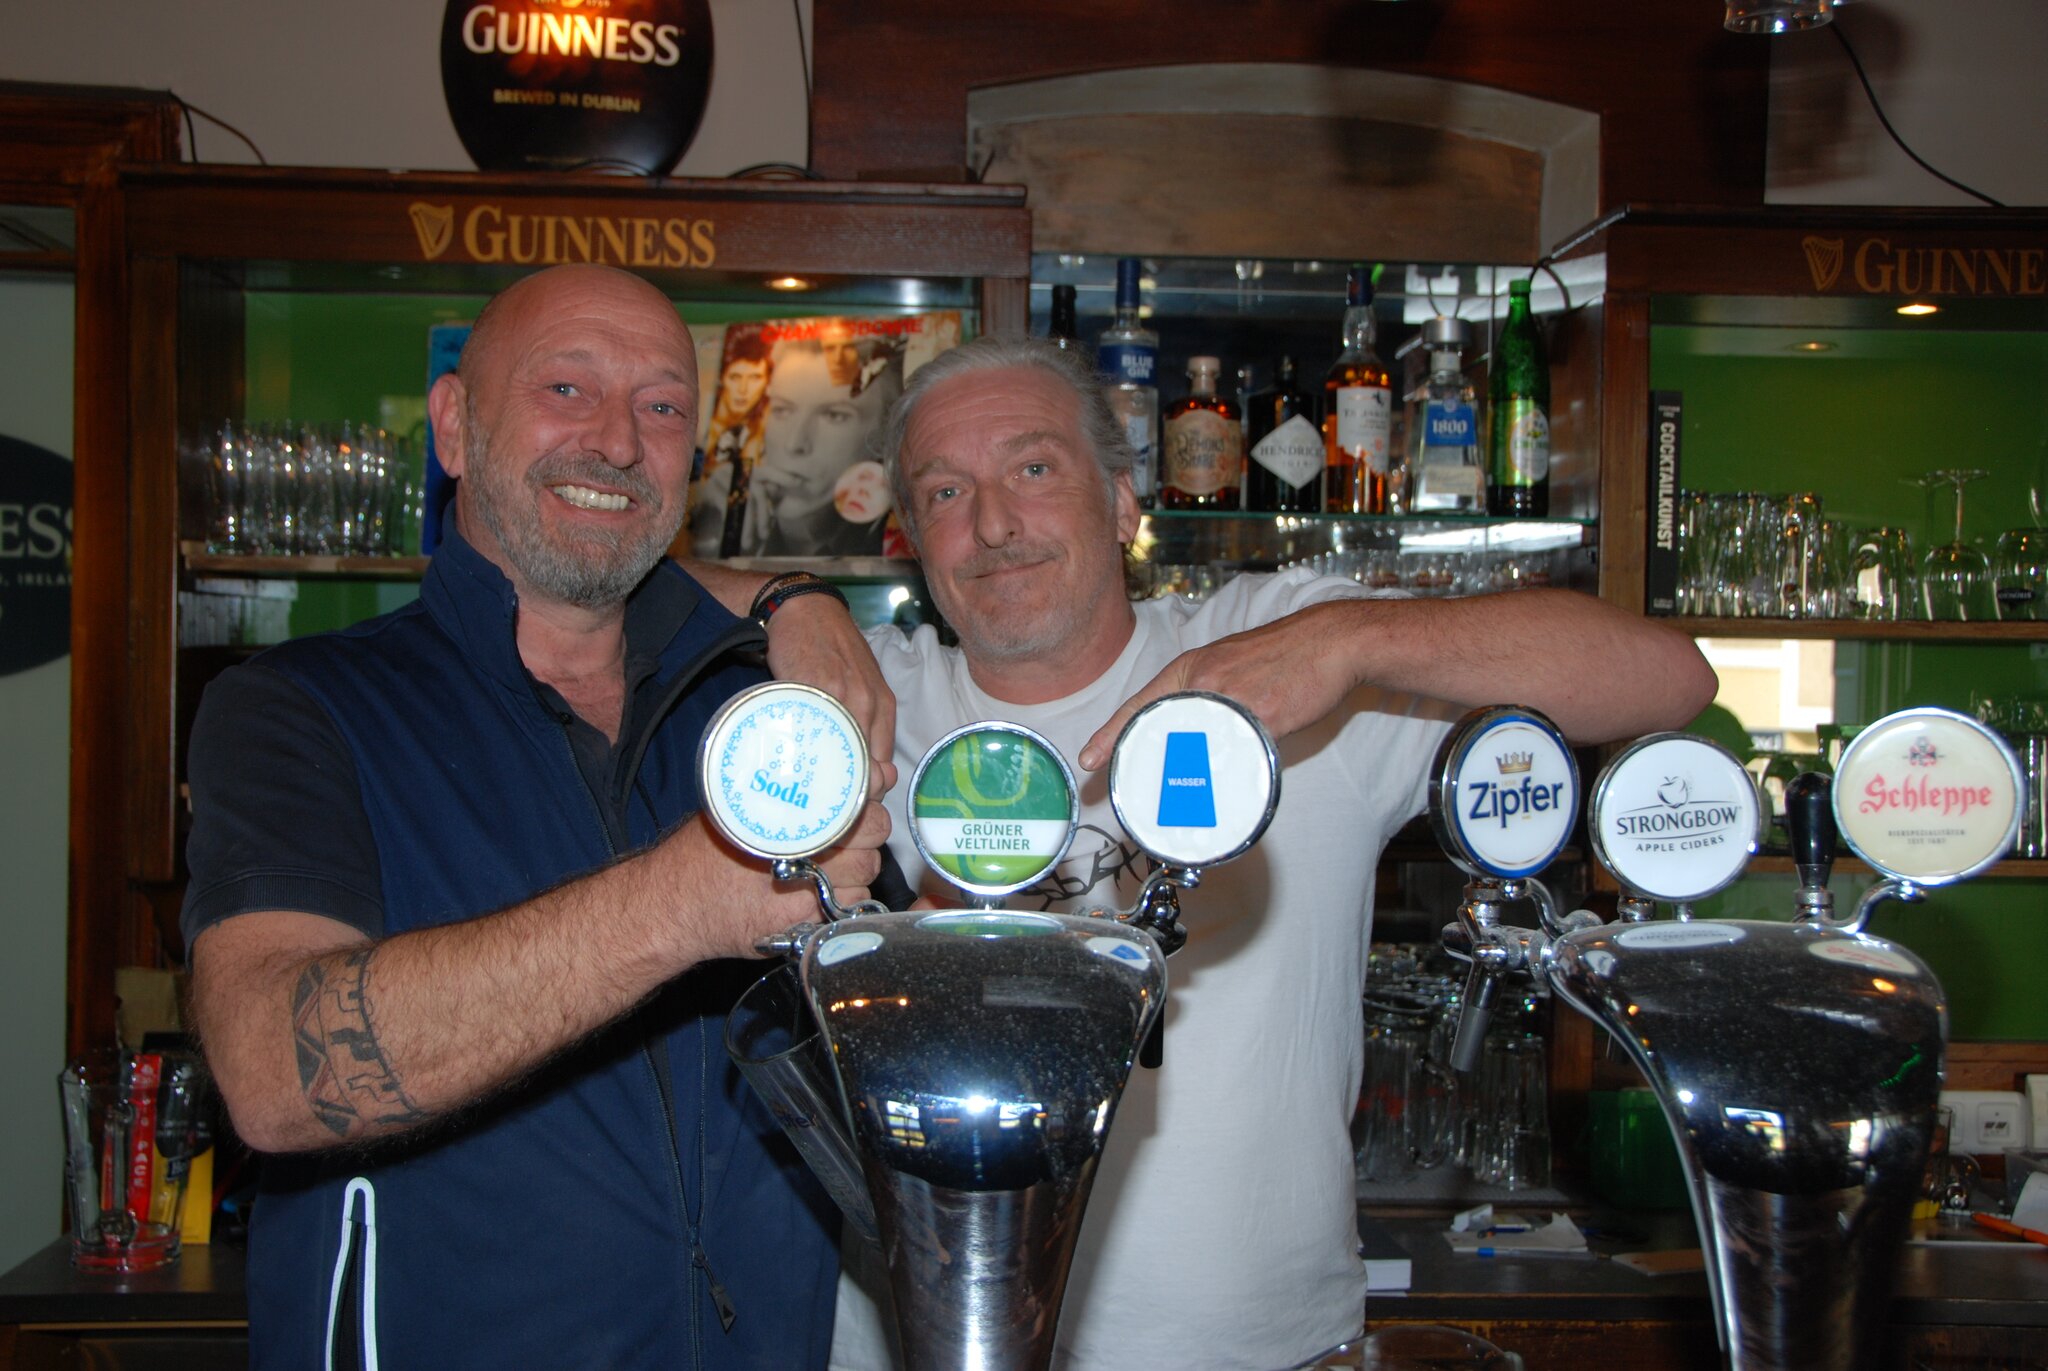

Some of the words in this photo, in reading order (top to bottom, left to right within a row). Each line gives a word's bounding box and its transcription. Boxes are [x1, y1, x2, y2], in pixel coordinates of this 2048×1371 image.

[462, 4, 681, 67] GUINNESS
[493, 88, 556, 105] BREWED
[559, 92, 578, 107] IN
[581, 93, 641, 113] DUBLIN
[463, 205, 716, 269] GUINNESS
[1121, 354, 1154, 370] BLUE
[1127, 366, 1150, 379] GIN
[1431, 419, 1468, 434] 1800
[1656, 422, 1676, 550] COCKTAILKUNST
[750, 768, 809, 809] Soda
[1167, 777, 1207, 787] WASSER
[1859, 773, 1992, 816] Schleppe
[1469, 776, 1564, 829] Zipfer
[962, 821, 1023, 836] GRÜNER
[1616, 806, 1738, 835] STRONGBOW
[954, 837, 1030, 850] VELTLINER
[1635, 843, 1675, 852] APPLE
[1680, 834, 1725, 851] CIDERS
